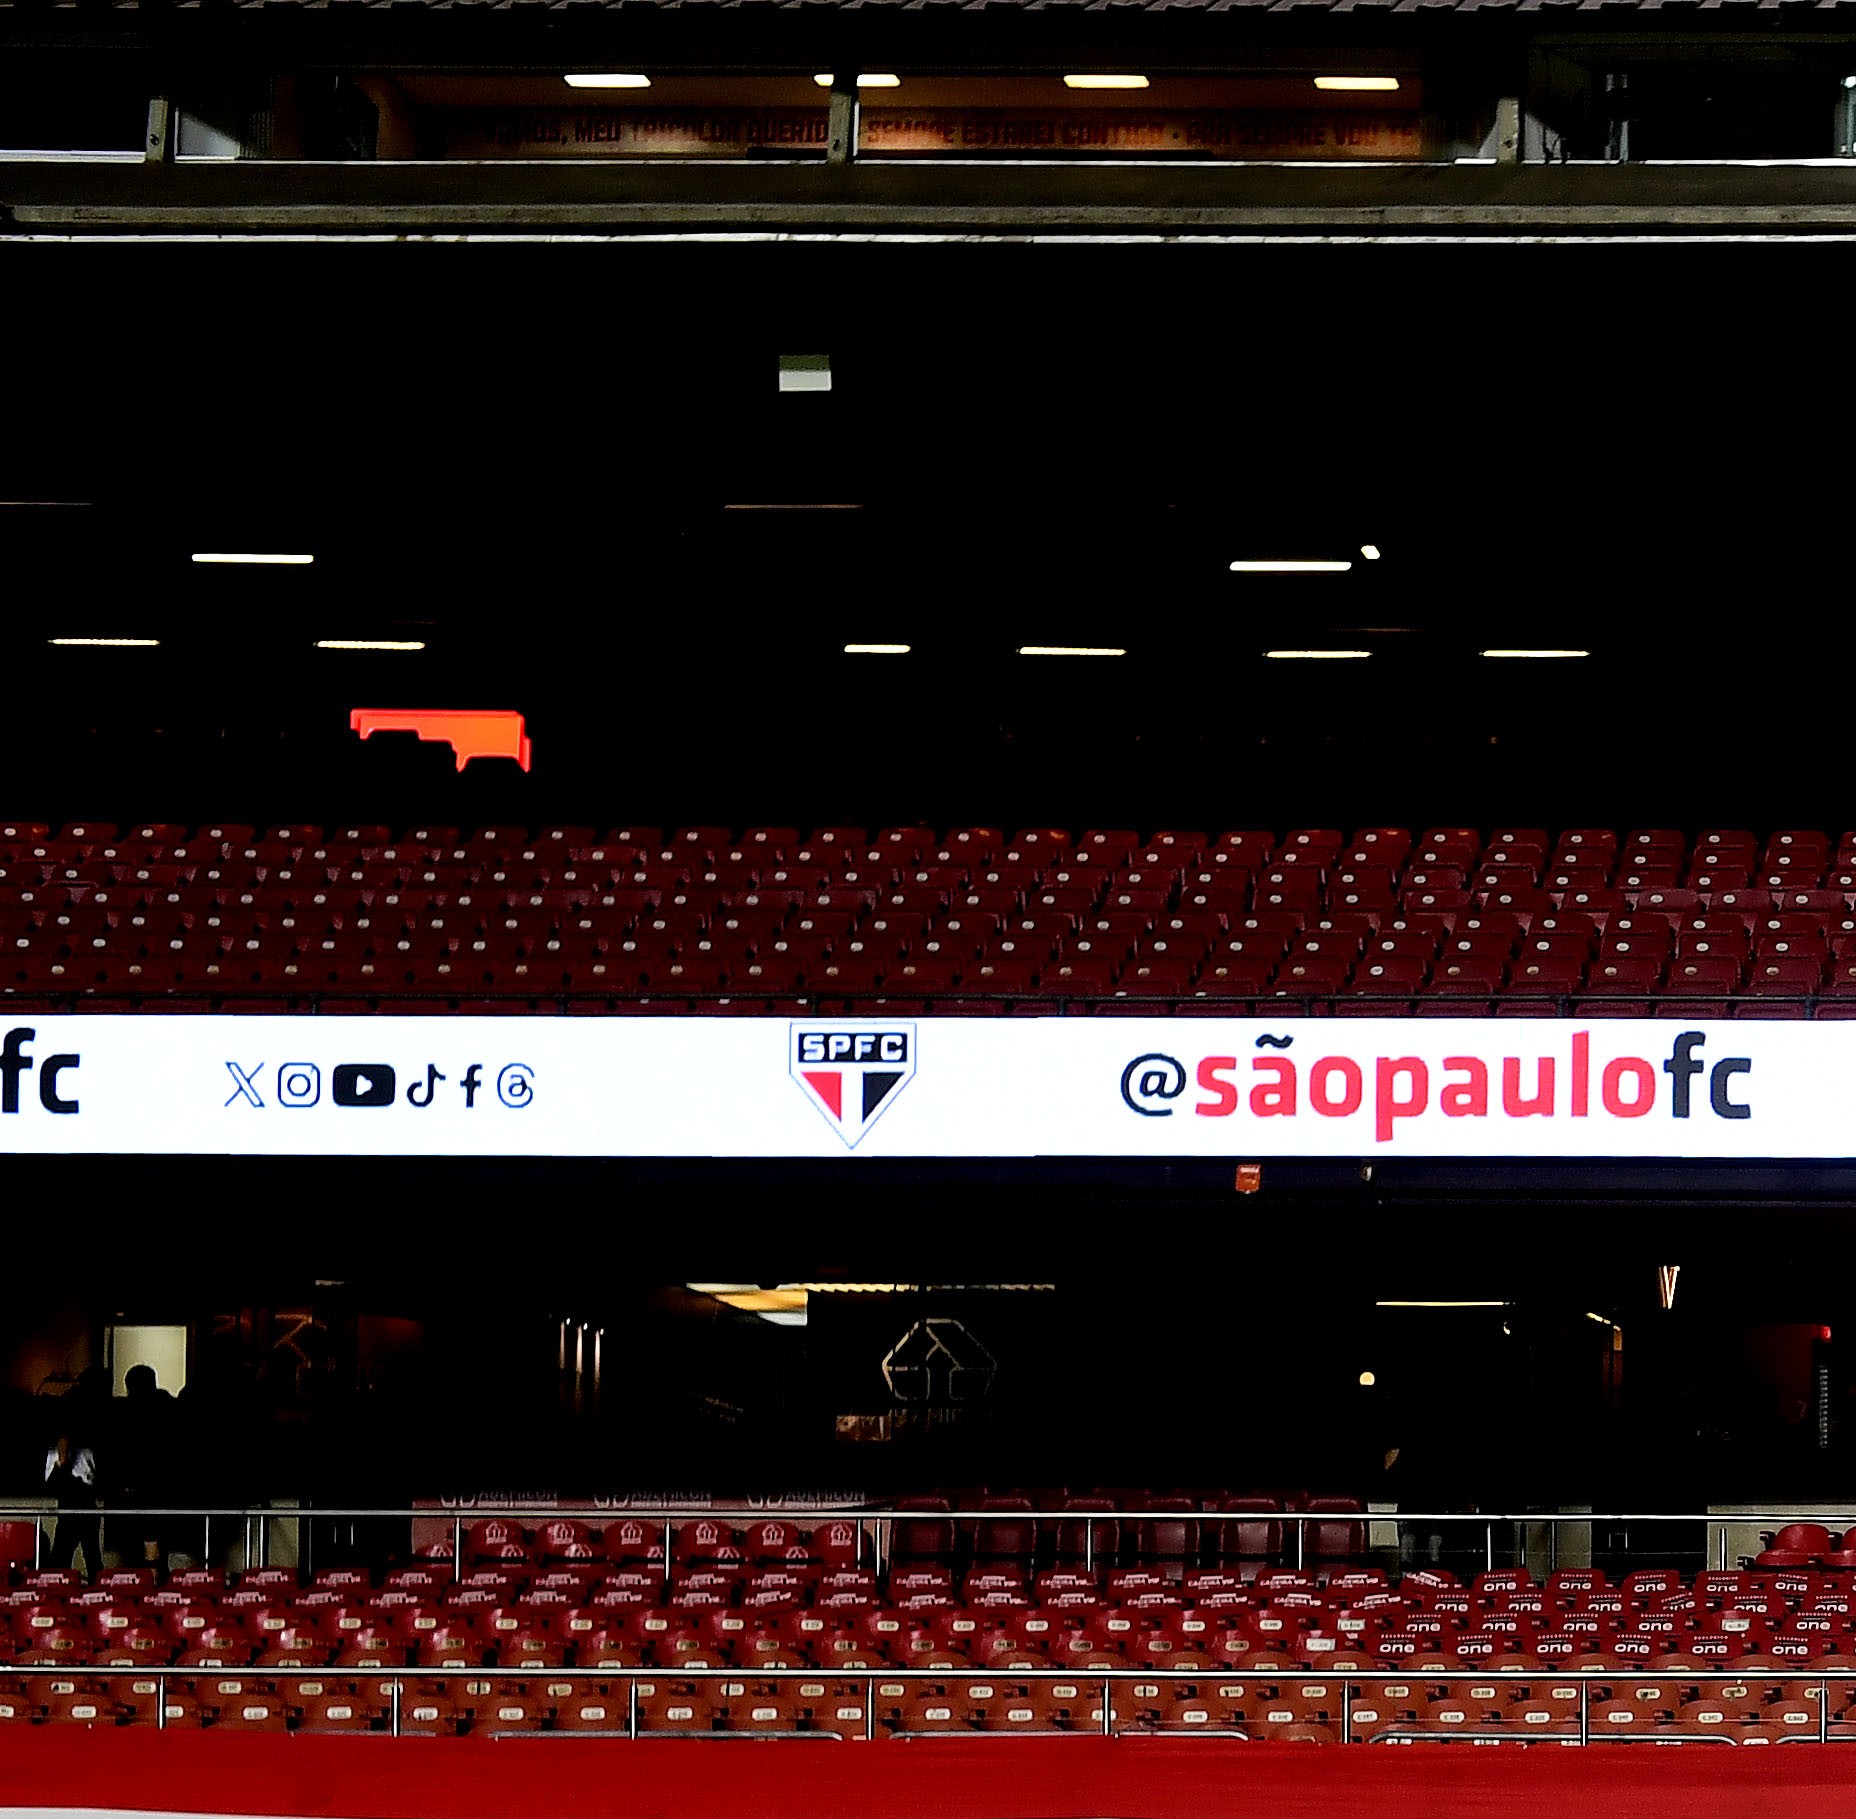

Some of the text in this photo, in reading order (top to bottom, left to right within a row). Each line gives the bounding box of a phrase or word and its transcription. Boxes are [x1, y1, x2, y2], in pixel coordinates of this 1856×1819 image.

[574, 118, 620, 143] MEU
[802, 1034, 904, 1061] SPFC
[1120, 1031, 1753, 1142] @sãopaulofc
